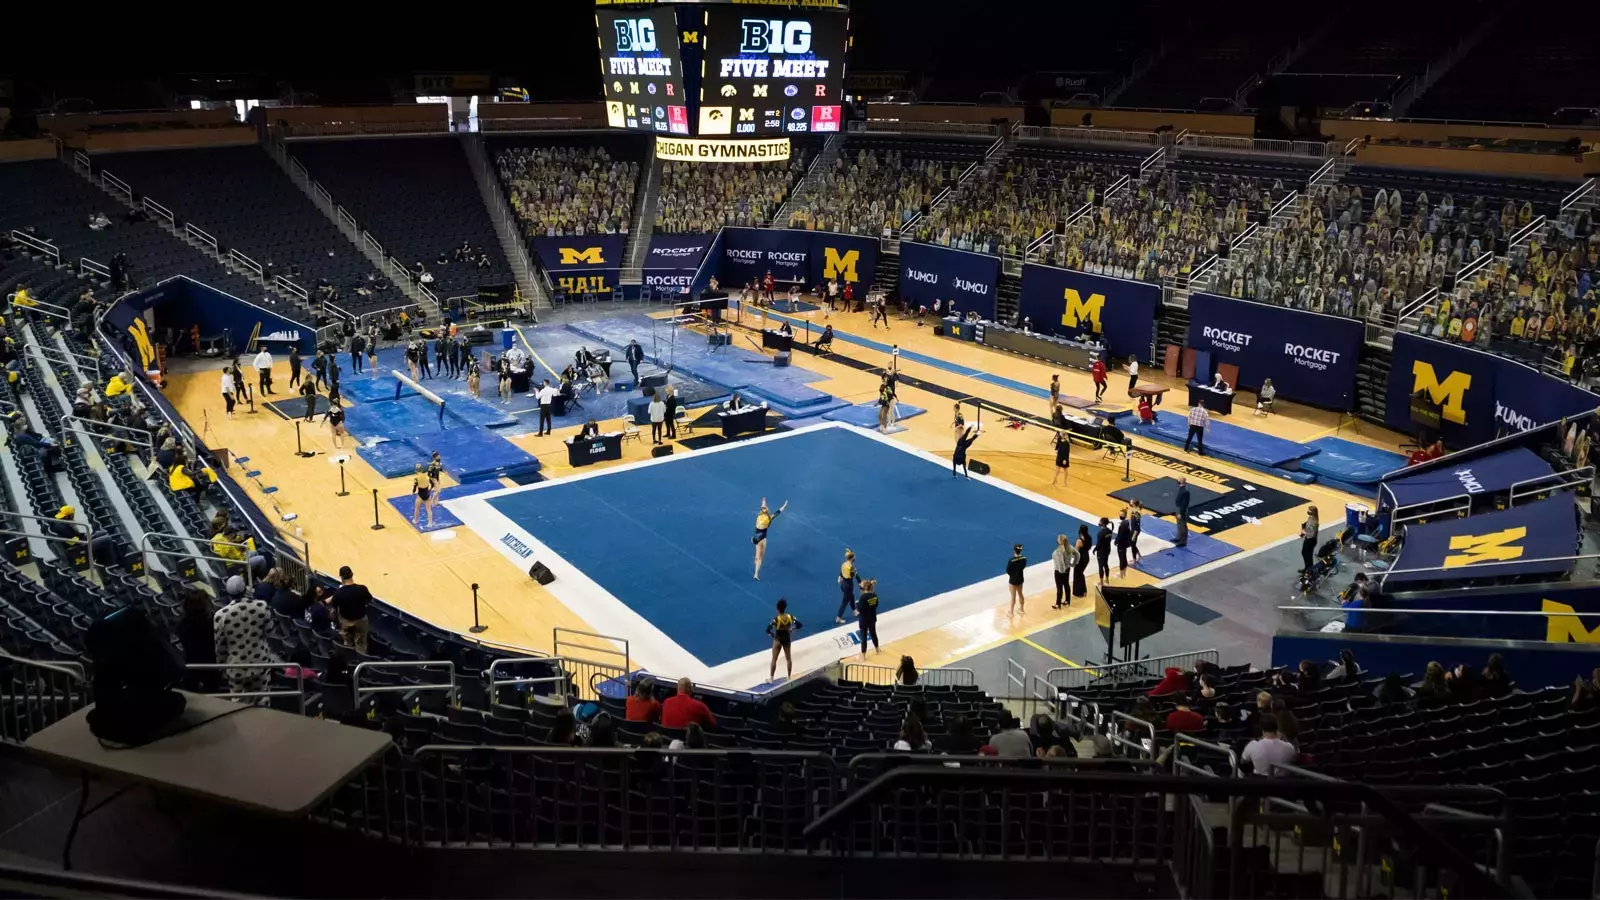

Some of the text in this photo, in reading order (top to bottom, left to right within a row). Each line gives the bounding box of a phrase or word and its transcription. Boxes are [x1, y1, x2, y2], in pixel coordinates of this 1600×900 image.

[683, 31, 698, 43] M
[610, 58, 671, 76] FIVE MEET
[720, 59, 829, 77] FIVE MEET
[666, 84, 674, 96] R
[753, 85, 769, 97] M
[815, 85, 826, 96] R
[739, 108, 755, 121] M
[820, 106, 833, 120] R
[698, 142, 788, 157] GYMNASTICS
[559, 247, 605, 264] M
[652, 246, 703, 254] ROCKET
[726, 249, 762, 259] ROCKET
[768, 251, 806, 261] ROCKET
[824, 247, 860, 282] M
[646, 276, 692, 286] ROCKET
[914, 270, 938, 284] UMCU
[559, 276, 611, 294] HAIL
[961, 281, 988, 295] UMCU
[1062, 288, 1105, 333] M
[1203, 326, 1252, 346] ROCKET
[1212, 339, 1241, 352] Mortgage
[1284, 343, 1340, 364] ROCKET
[1294, 357, 1327, 370] Mortgage
[1413, 360, 1472, 425] M
[1503, 409, 1538, 432] UMCU
[590, 446, 606, 454] FLOOR
[1213, 497, 1265, 515] BELFOR
[500, 532, 534, 559] MICHIGAN
